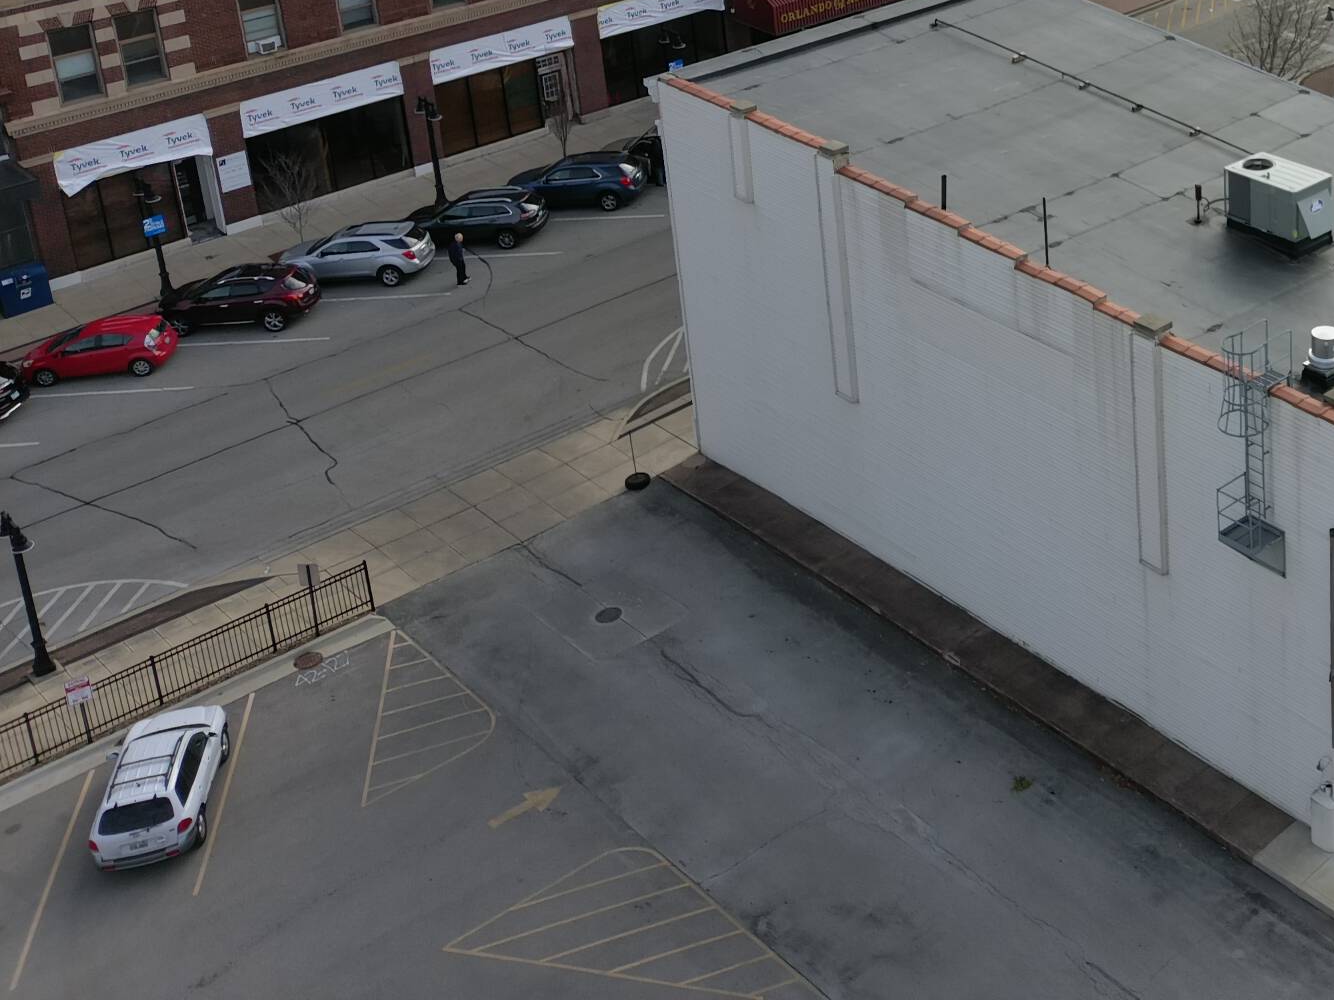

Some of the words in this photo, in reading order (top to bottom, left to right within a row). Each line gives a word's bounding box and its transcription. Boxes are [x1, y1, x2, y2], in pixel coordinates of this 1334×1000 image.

[626, 8, 647, 19] Tyvek
[660, 0, 680, 10] Tyvek
[781, 0, 833, 23] ORLANDO
[432, 58, 455, 71] Tyvek
[471, 49, 493, 61] Tyvek
[508, 39, 530, 52] Tyvek
[545, 30, 567, 42] Tyvek
[247, 109, 273, 123] Tyvek
[290, 97, 316, 111] Tyvek
[332, 86, 358, 100] Tyvek
[374, 75, 398, 89] Tyvek
[71, 157, 101, 172] Tyvek
[120, 144, 149, 159] Tyvek
[166, 131, 193, 146] Tyvek
